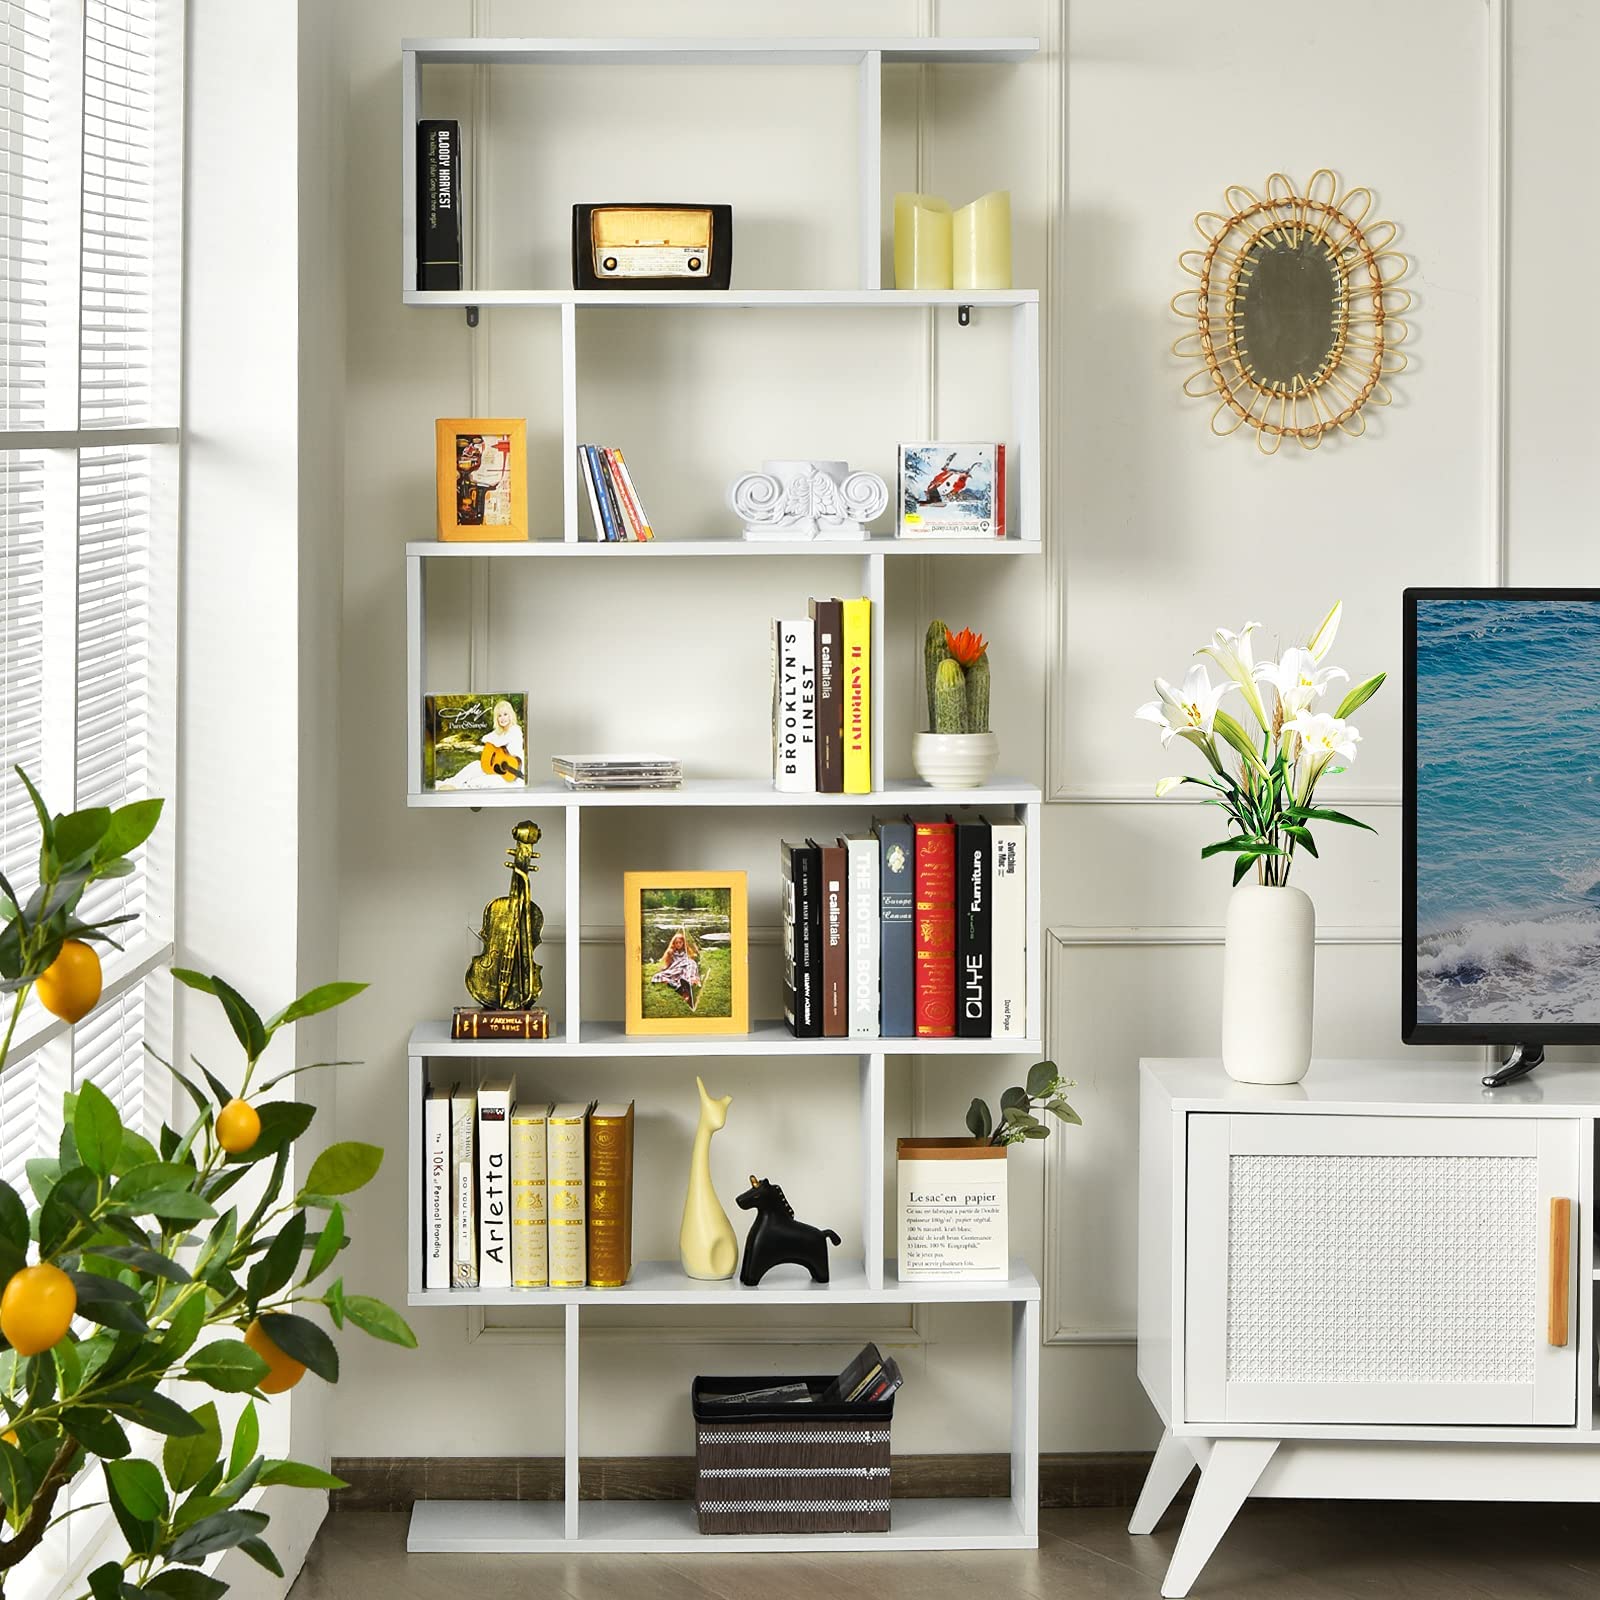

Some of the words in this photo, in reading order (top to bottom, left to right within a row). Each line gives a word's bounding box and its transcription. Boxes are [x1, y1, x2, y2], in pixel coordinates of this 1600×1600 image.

[439, 131, 450, 166] BLOODY
[439, 169, 450, 209] HARVEST
[822, 647, 832, 698] caliaitalia
[785, 635, 796, 774] BROOKLYN'S
[803, 665, 814, 743] FINEST
[856, 852, 871, 889] THE
[998, 854, 1006, 867] Mac
[1007, 842, 1016, 873] Switching
[971, 850, 982, 912] Furniture
[829, 894, 840, 946] caliaitalia
[856, 894, 871, 954] HOTEL
[856, 959, 871, 1012] BOOK
[433, 1150, 443, 1176] 10Ks
[462, 1177, 468, 1189] DO
[910, 1192, 923, 1202] Le
[965, 1193, 996, 1205] papier
[433, 1186, 442, 1220] Personal
[484, 1153, 503, 1263] Arletta
[433, 1224, 441, 1258] Branding
